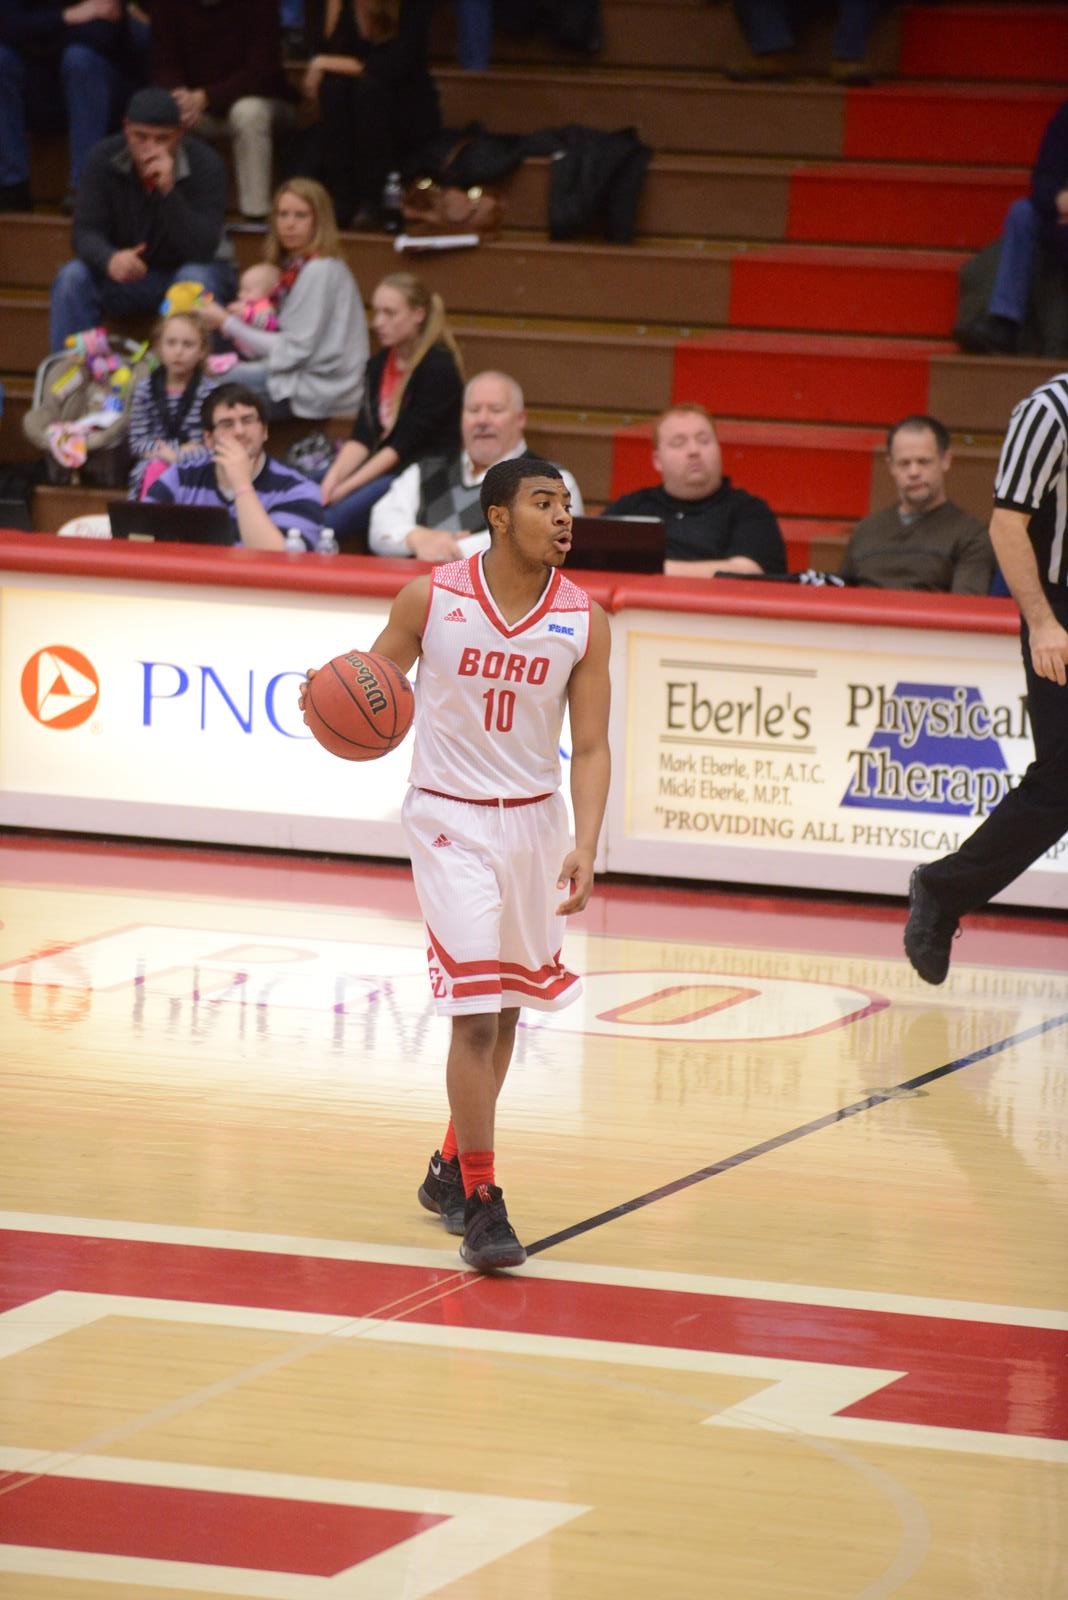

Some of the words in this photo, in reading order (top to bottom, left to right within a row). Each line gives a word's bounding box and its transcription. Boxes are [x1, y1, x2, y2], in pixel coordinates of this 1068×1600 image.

[345, 654, 388, 715] Wilson
[457, 647, 550, 685] BORO
[482, 687, 516, 732] 10
[665, 680, 812, 741] Eberle's
[846, 683, 1030, 747] Physical
[659, 752, 697, 773] Mark
[701, 755, 749, 781] Eberle,
[784, 762, 825, 785] A.T.C.
[658, 776, 696, 799] Micki
[700, 780, 749, 804] Eberle,
[754, 784, 793, 806] M.P.T.
[655, 805, 794, 840] "PROVIDING
[801, 821, 845, 843] ALL
